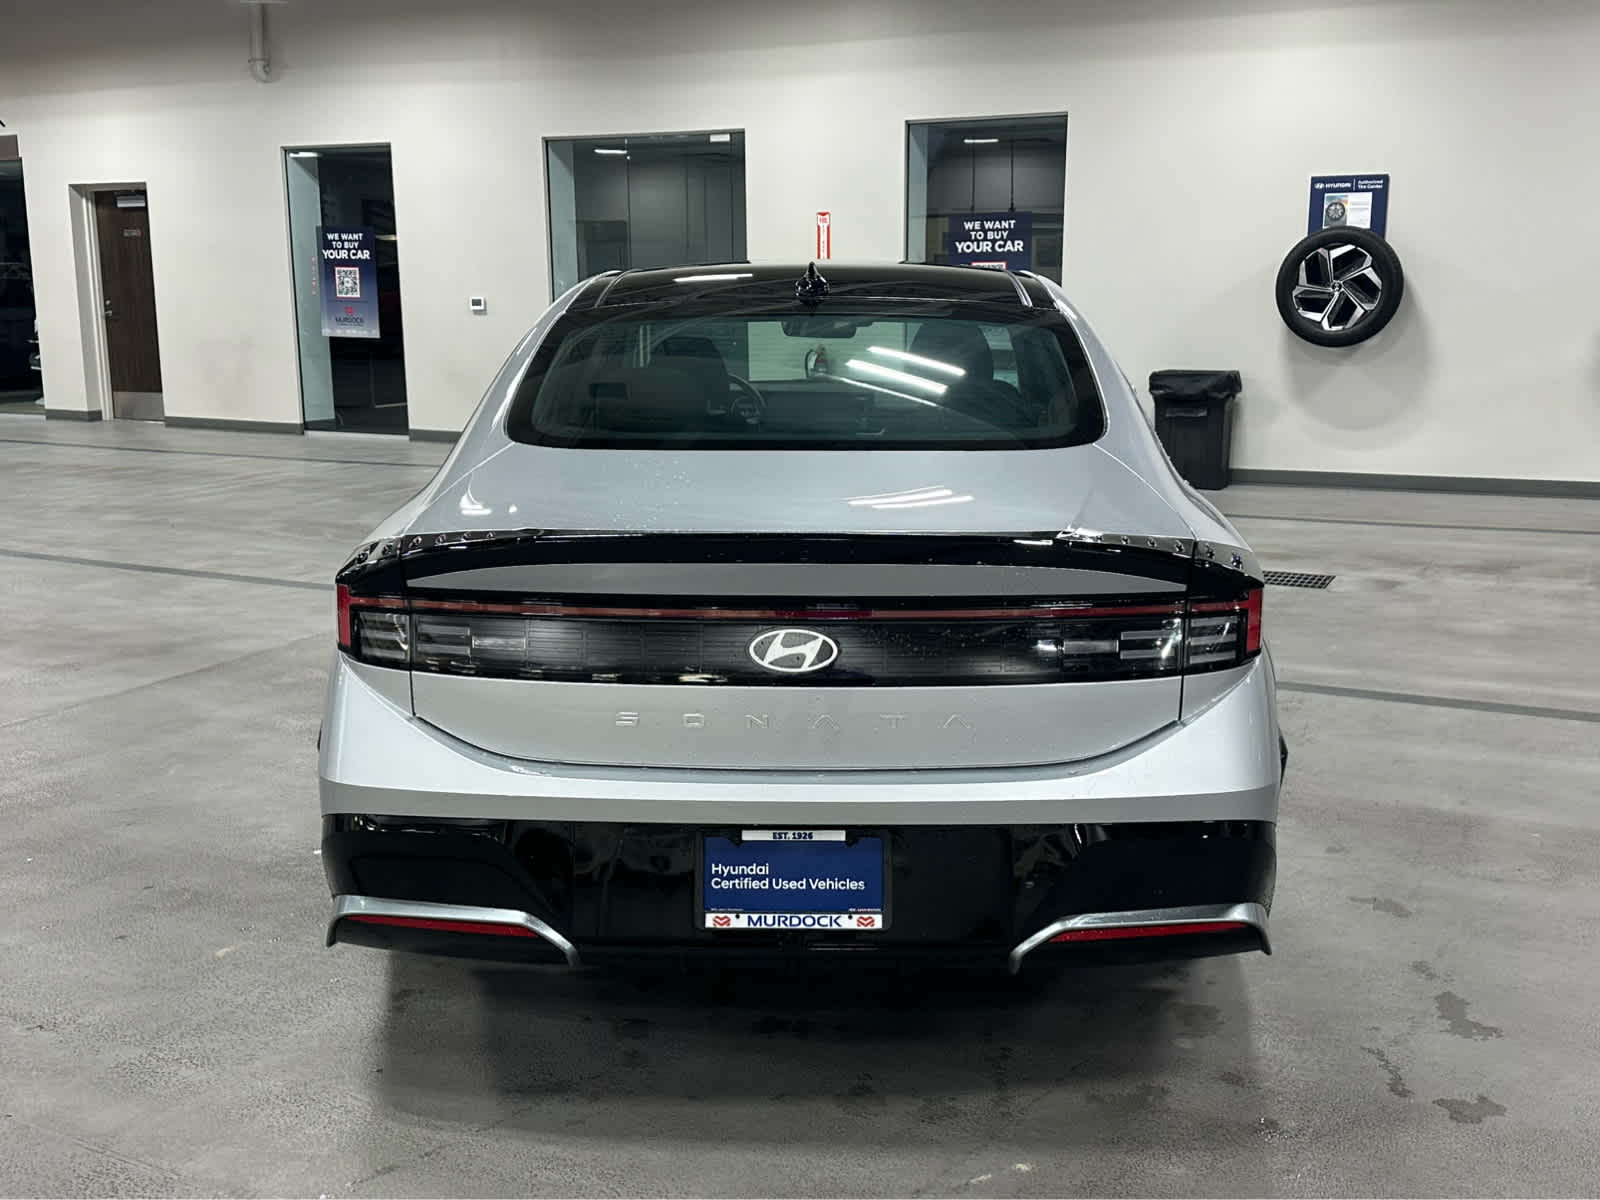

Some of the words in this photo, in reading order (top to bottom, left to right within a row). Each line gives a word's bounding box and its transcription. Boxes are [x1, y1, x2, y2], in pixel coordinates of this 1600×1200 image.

[963, 221, 982, 230] WE
[984, 220, 1016, 229] WANT
[326, 233, 339, 241] WE
[341, 233, 363, 241] WANT
[970, 231, 985, 240] TO
[987, 230, 1009, 239] BUY
[332, 241, 343, 249] TO
[344, 241, 359, 249] BUY
[955, 241, 992, 253] YOUR
[994, 240, 1024, 252] CAR
[322, 249, 349, 260] YOUR
[350, 249, 370, 260] CAR
[615, 711, 971, 729] SONATA
[772, 831, 790, 840] EST.
[792, 831, 814, 840] 1926
[711, 863, 769, 877] Hyundai
[711, 877, 769, 890] Certified
[772, 878, 806, 890] Used
[809, 878, 865, 890] Vehicles
[747, 914, 842, 928] MURDOCK
